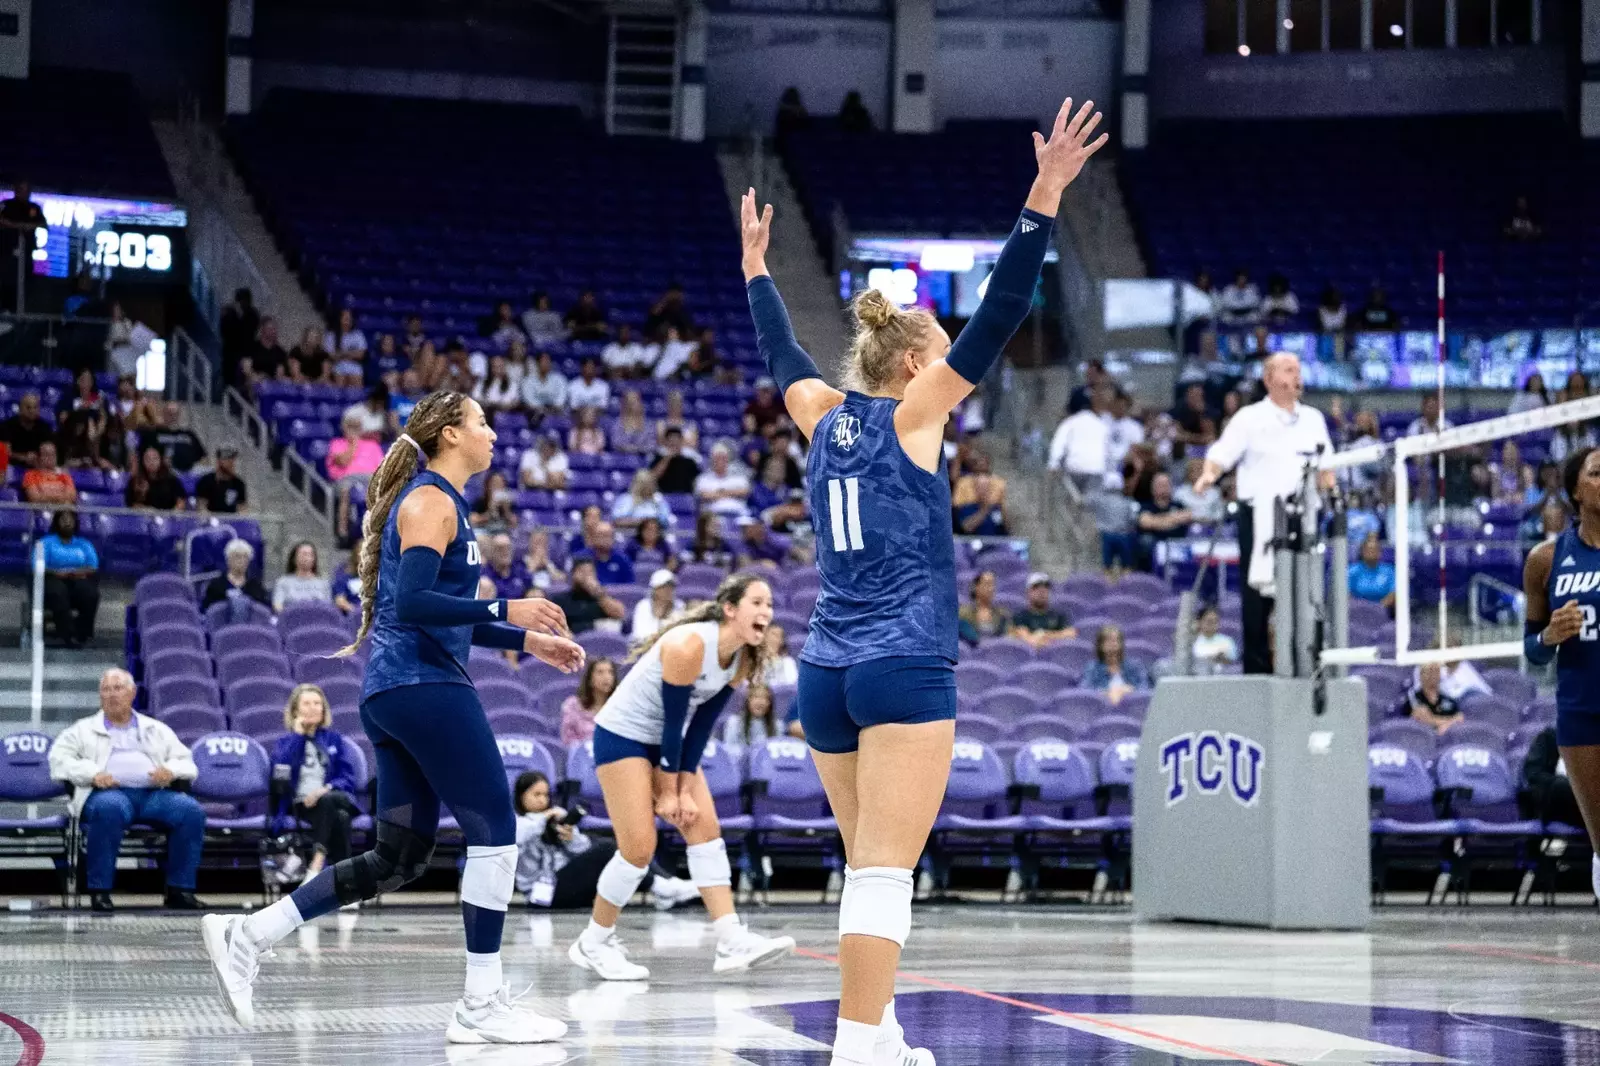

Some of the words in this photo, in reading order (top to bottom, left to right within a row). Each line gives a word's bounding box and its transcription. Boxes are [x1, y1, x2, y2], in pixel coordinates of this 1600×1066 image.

[828, 477, 865, 551] 11
[1554, 571, 1600, 597] OW
[1578, 604, 1600, 641] 2
[4, 735, 48, 755] TCU
[206, 736, 250, 756] TCU
[1159, 730, 1265, 808] TCU
